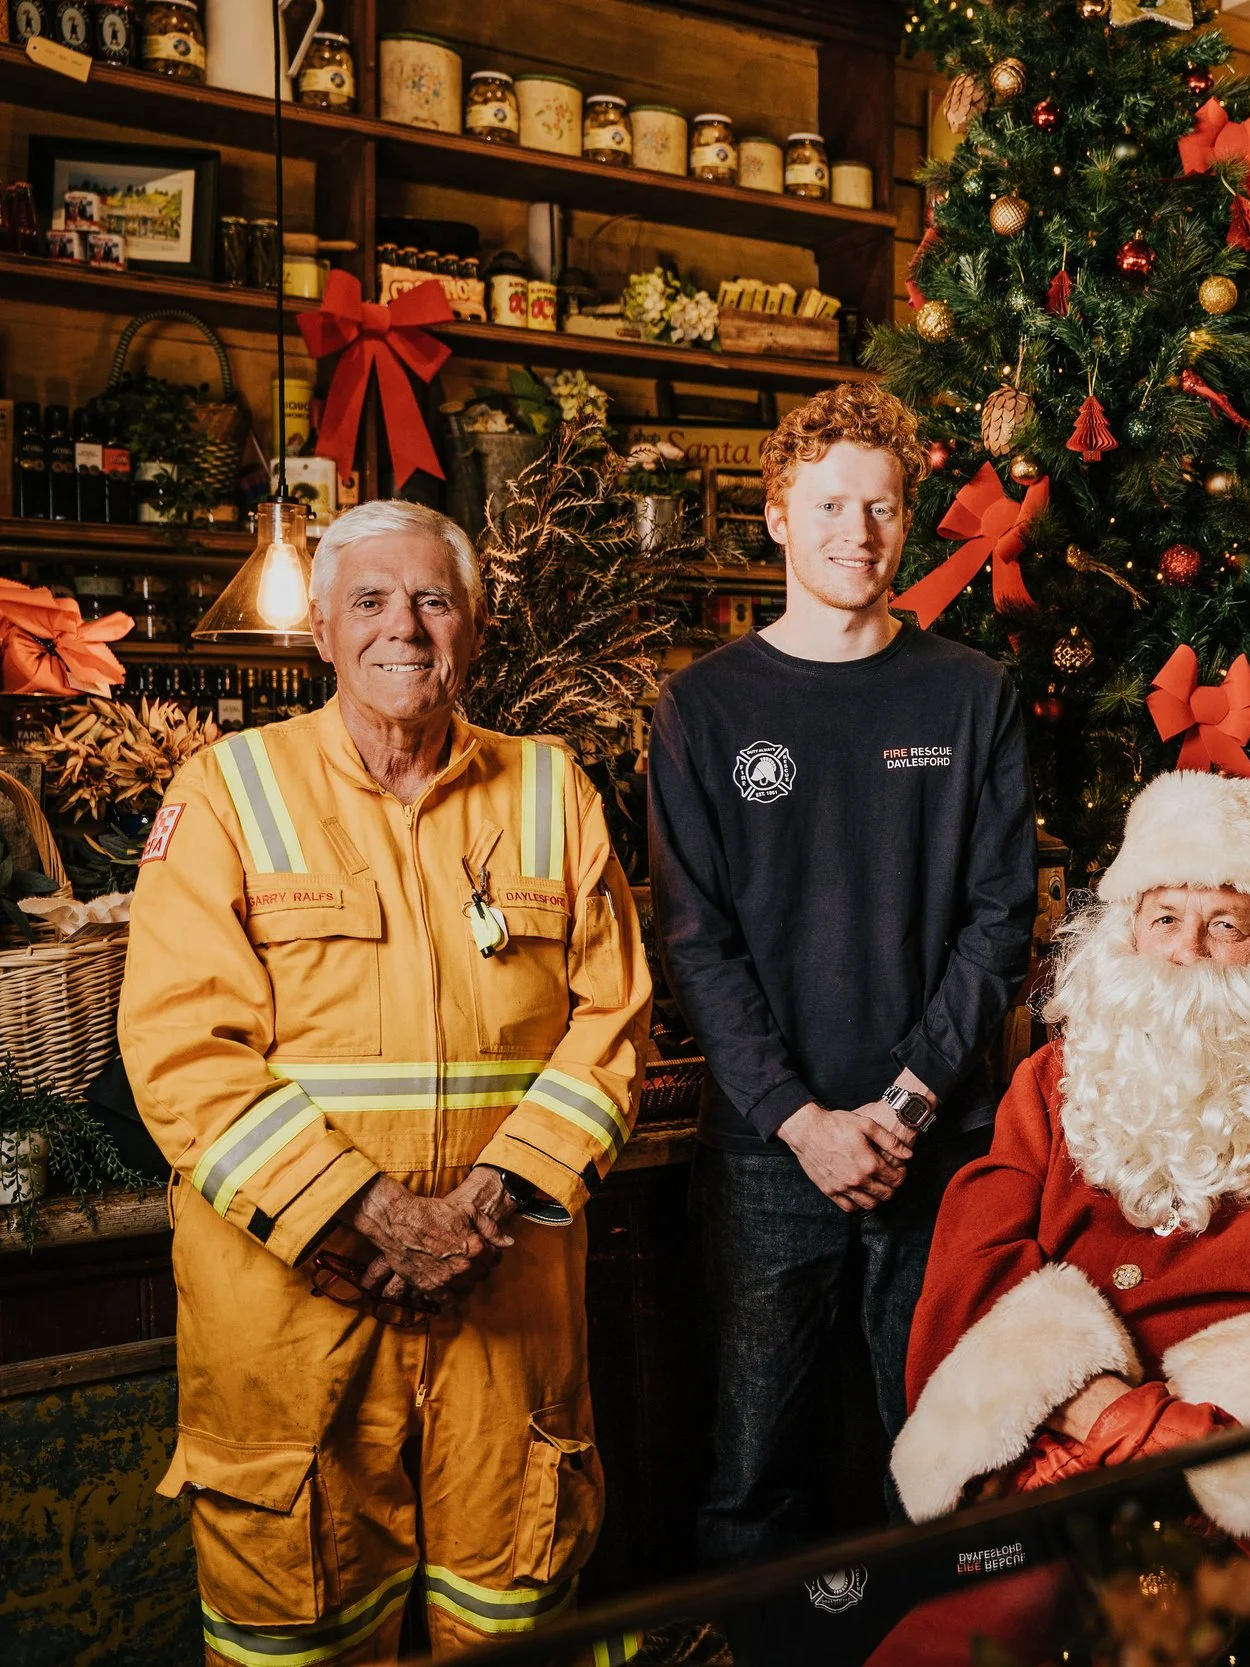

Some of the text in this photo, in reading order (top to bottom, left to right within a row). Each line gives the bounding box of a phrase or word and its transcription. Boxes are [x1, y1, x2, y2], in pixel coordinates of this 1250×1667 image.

[668, 430, 752, 465] Santa
[883, 746, 953, 759] FIRE RESCUE
[782, 754, 790, 782] RESCUE
[887, 757, 951, 769] DAYLESFORD
[739, 764, 747, 786] FIRE
[249, 892, 334, 907] GARRY RALFS
[505, 891, 566, 908] DAYLESFOR
